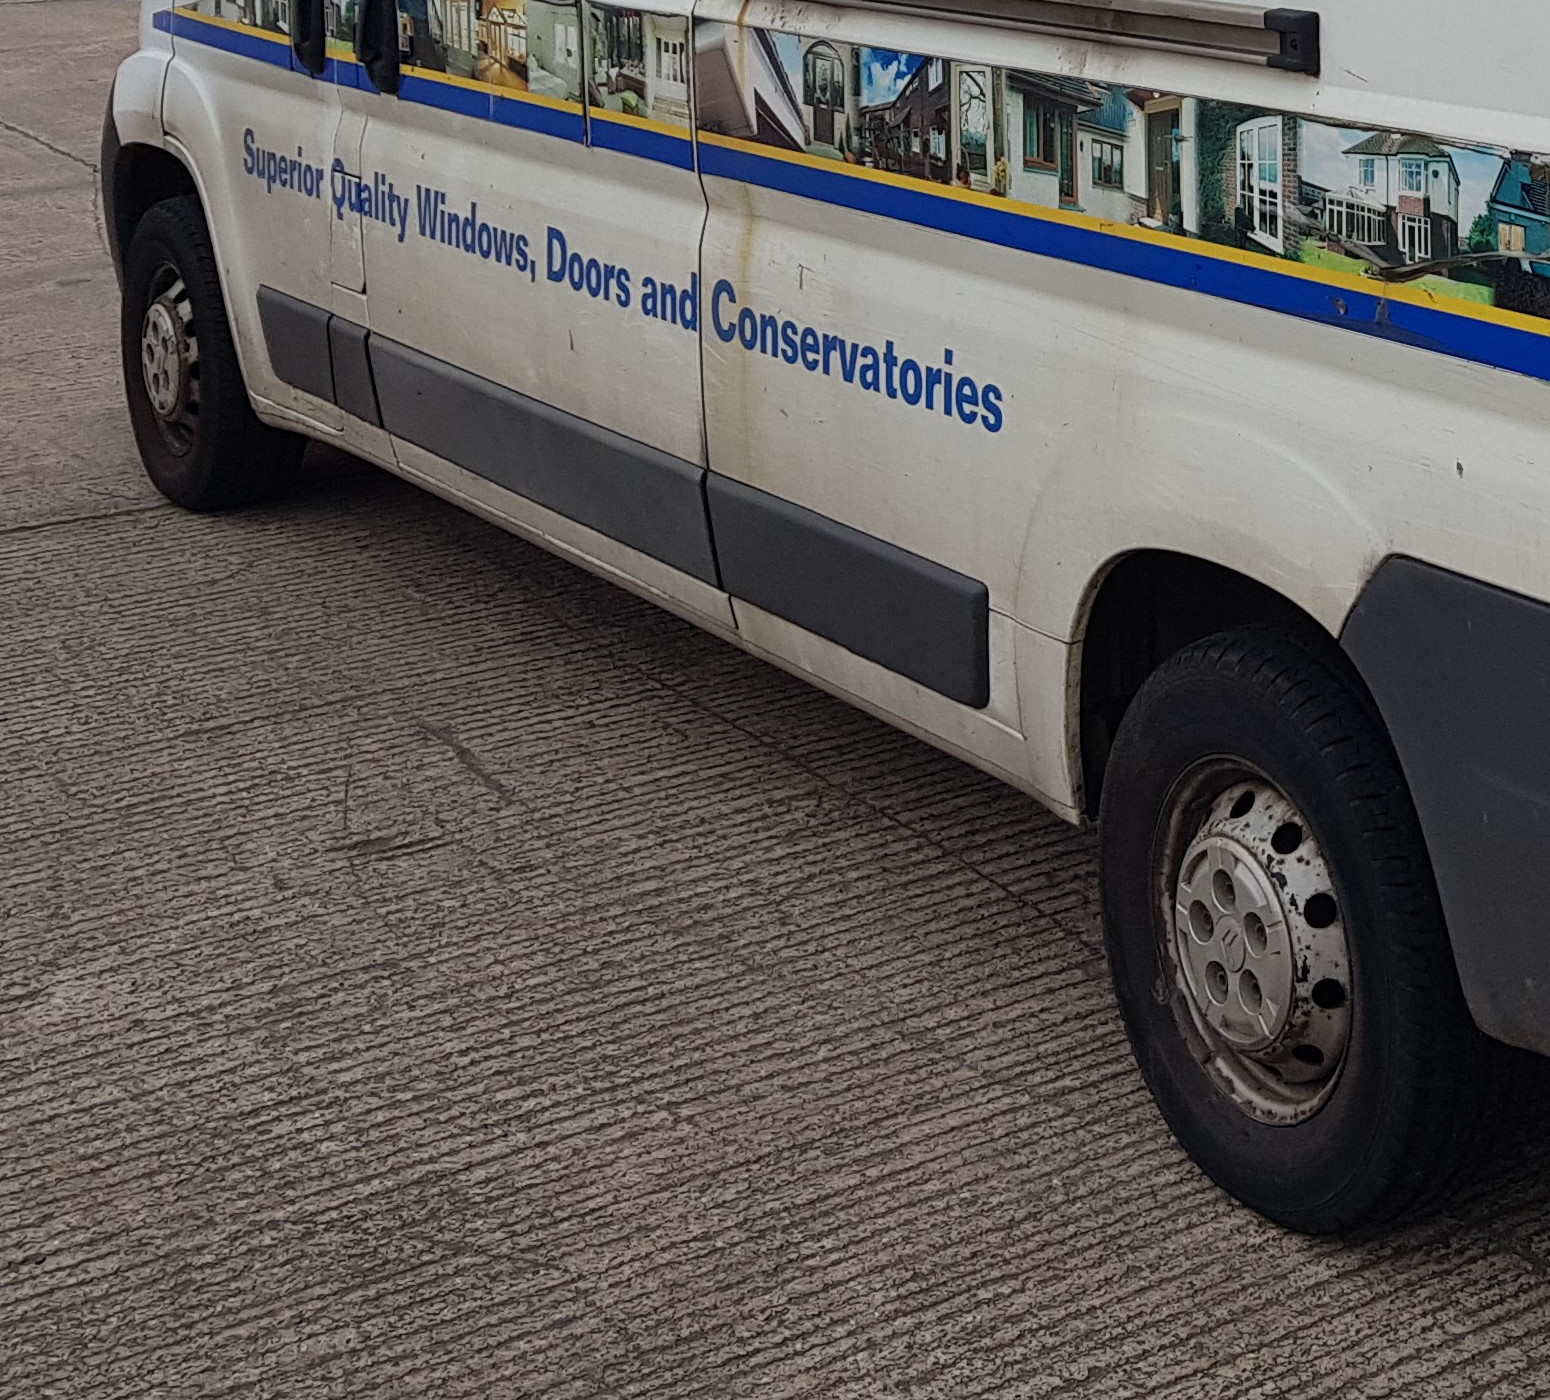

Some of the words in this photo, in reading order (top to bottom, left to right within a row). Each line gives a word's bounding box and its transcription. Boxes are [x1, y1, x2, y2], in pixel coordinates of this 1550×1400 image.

[243, 128, 324, 200] Superior
[331, 157, 410, 243] Quality
[416, 183, 537, 283] Windows,
[546, 224, 632, 308] Doors
[641, 271, 698, 332] and
[711, 279, 1003, 433] Conservatories
